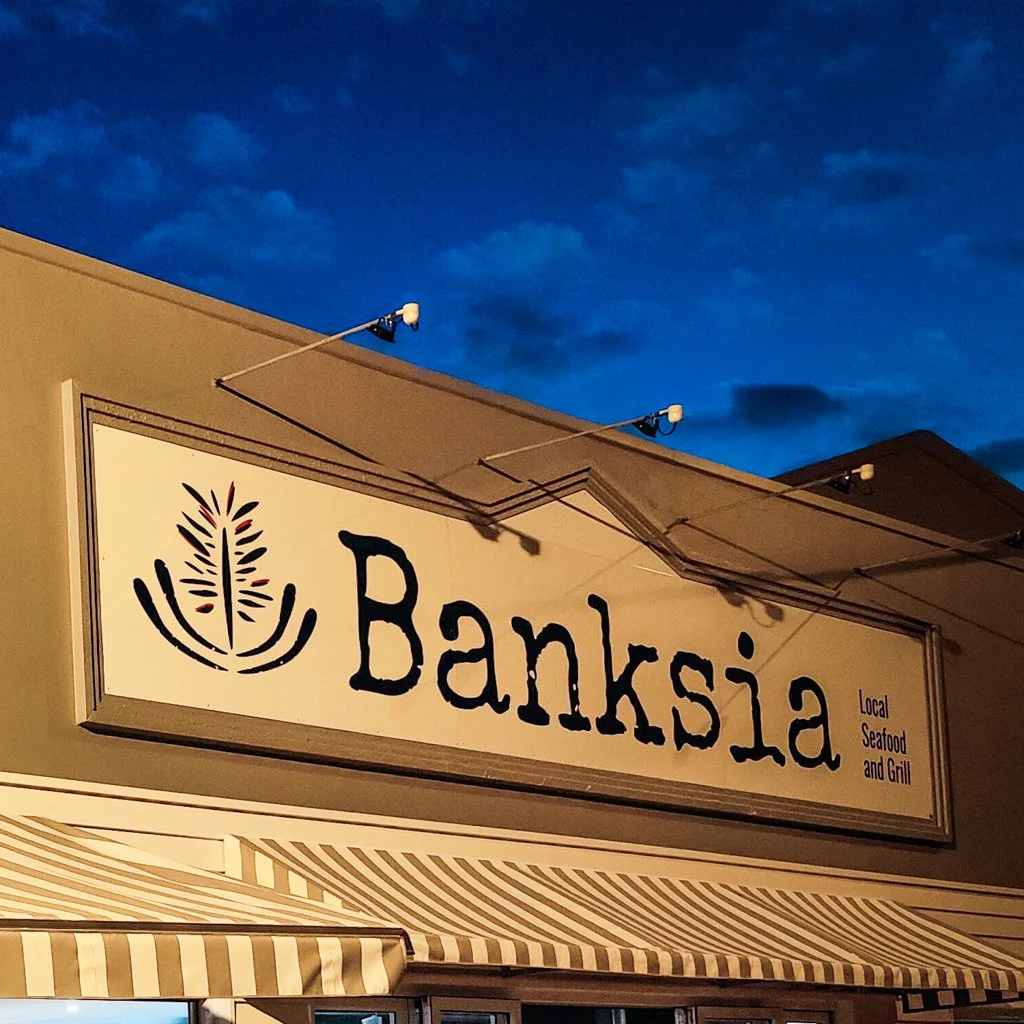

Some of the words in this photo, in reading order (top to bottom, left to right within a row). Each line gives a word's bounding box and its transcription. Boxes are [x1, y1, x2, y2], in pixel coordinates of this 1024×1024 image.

[338, 529, 841, 771] Banksia
[858, 688, 889, 719] Local
[861, 722, 906, 754] Seafood
[863, 756, 884, 781] and
[887, 757, 911, 785] Grill
